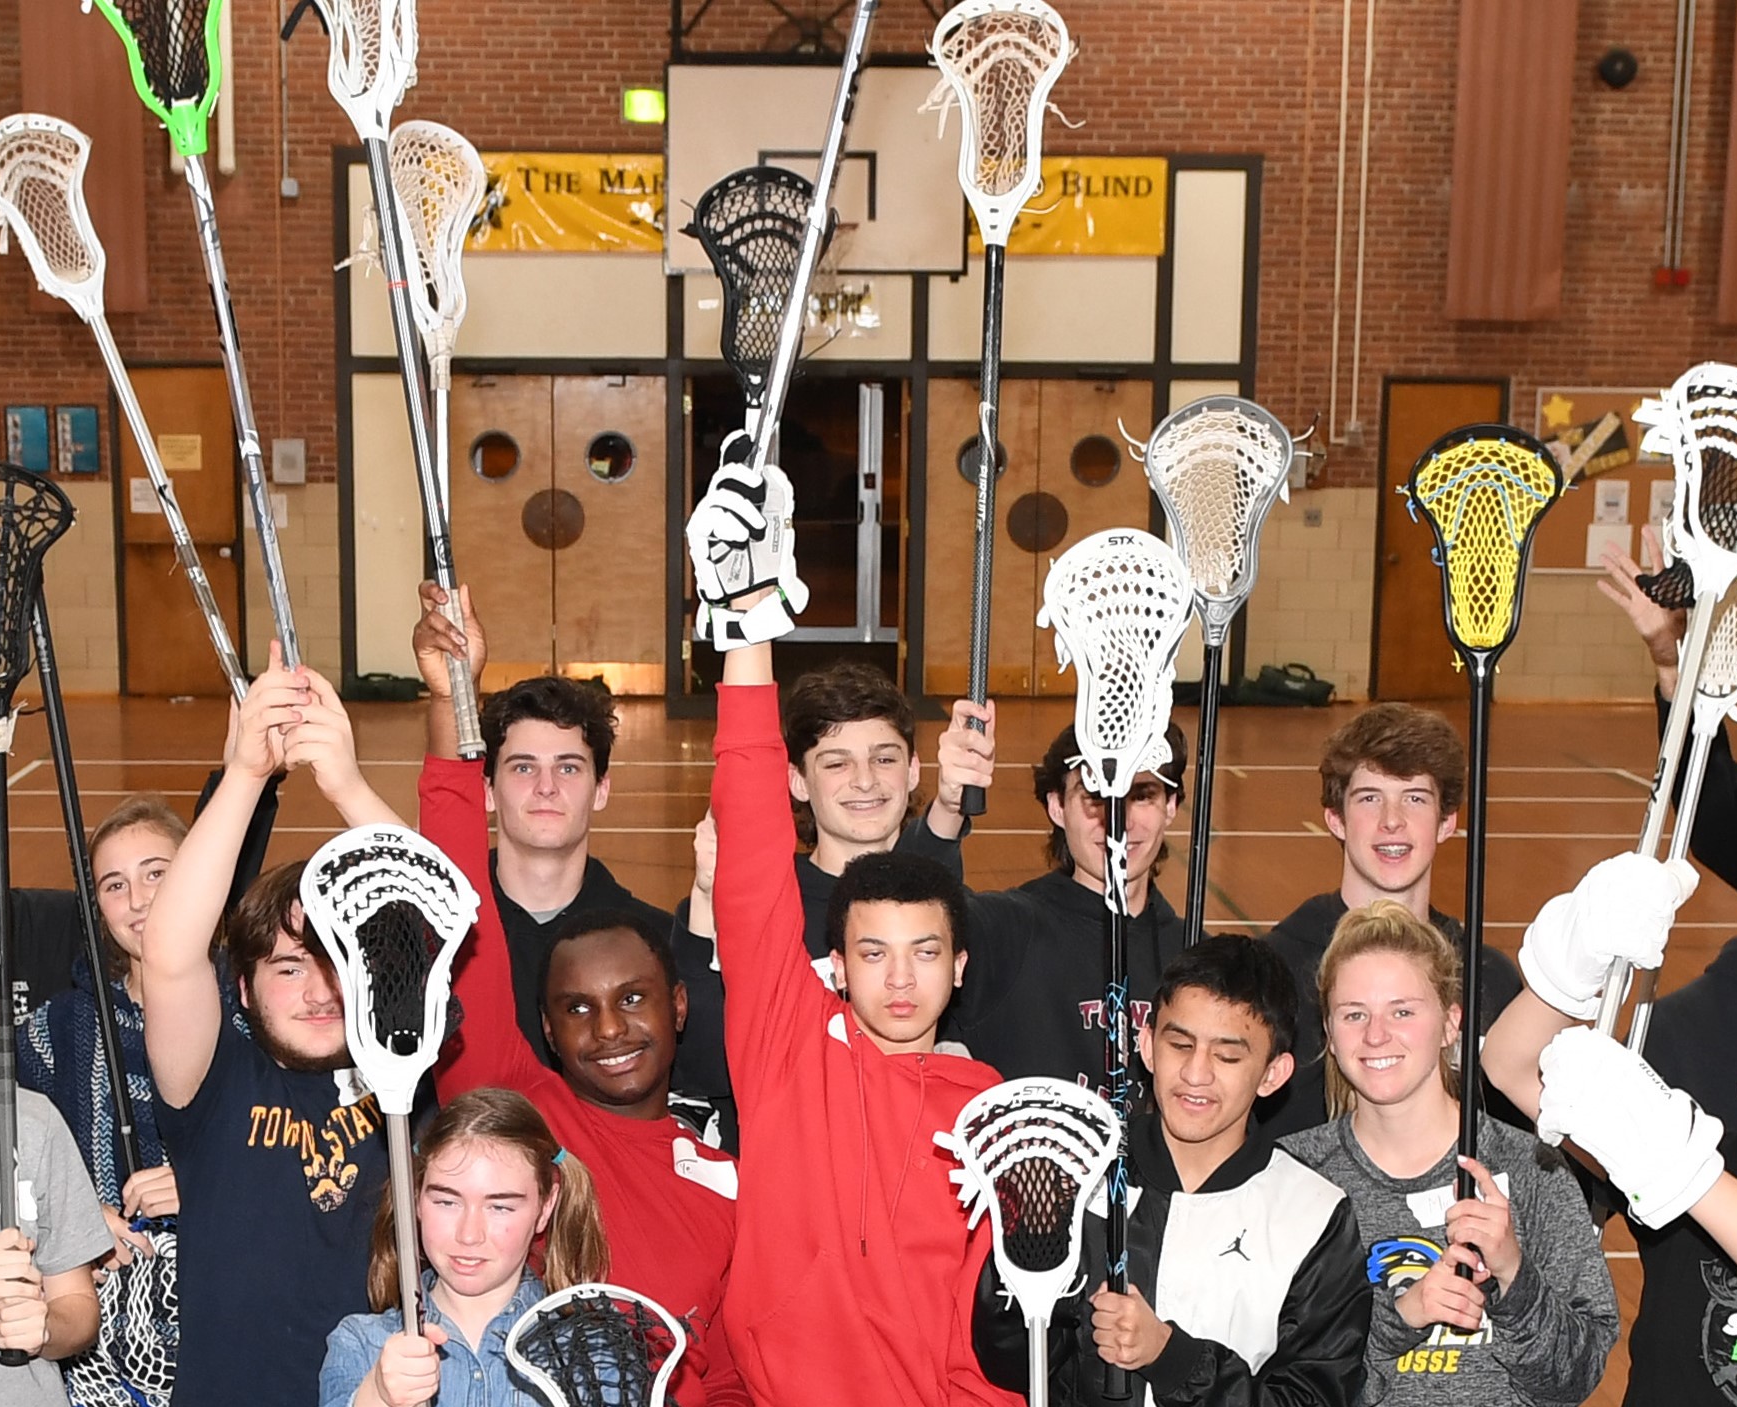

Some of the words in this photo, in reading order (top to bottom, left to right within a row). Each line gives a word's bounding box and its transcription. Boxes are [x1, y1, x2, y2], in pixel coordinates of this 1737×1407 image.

[1061, 169, 1153, 197] BLIND
[1108, 535, 1134, 546] STX
[373, 832, 404, 844] STX
[1023, 1085, 1053, 1096] STX
[247, 1105, 317, 1161] TOWN
[320, 1094, 383, 1163] STAT
[1395, 1349, 1461, 1374] OSSE
